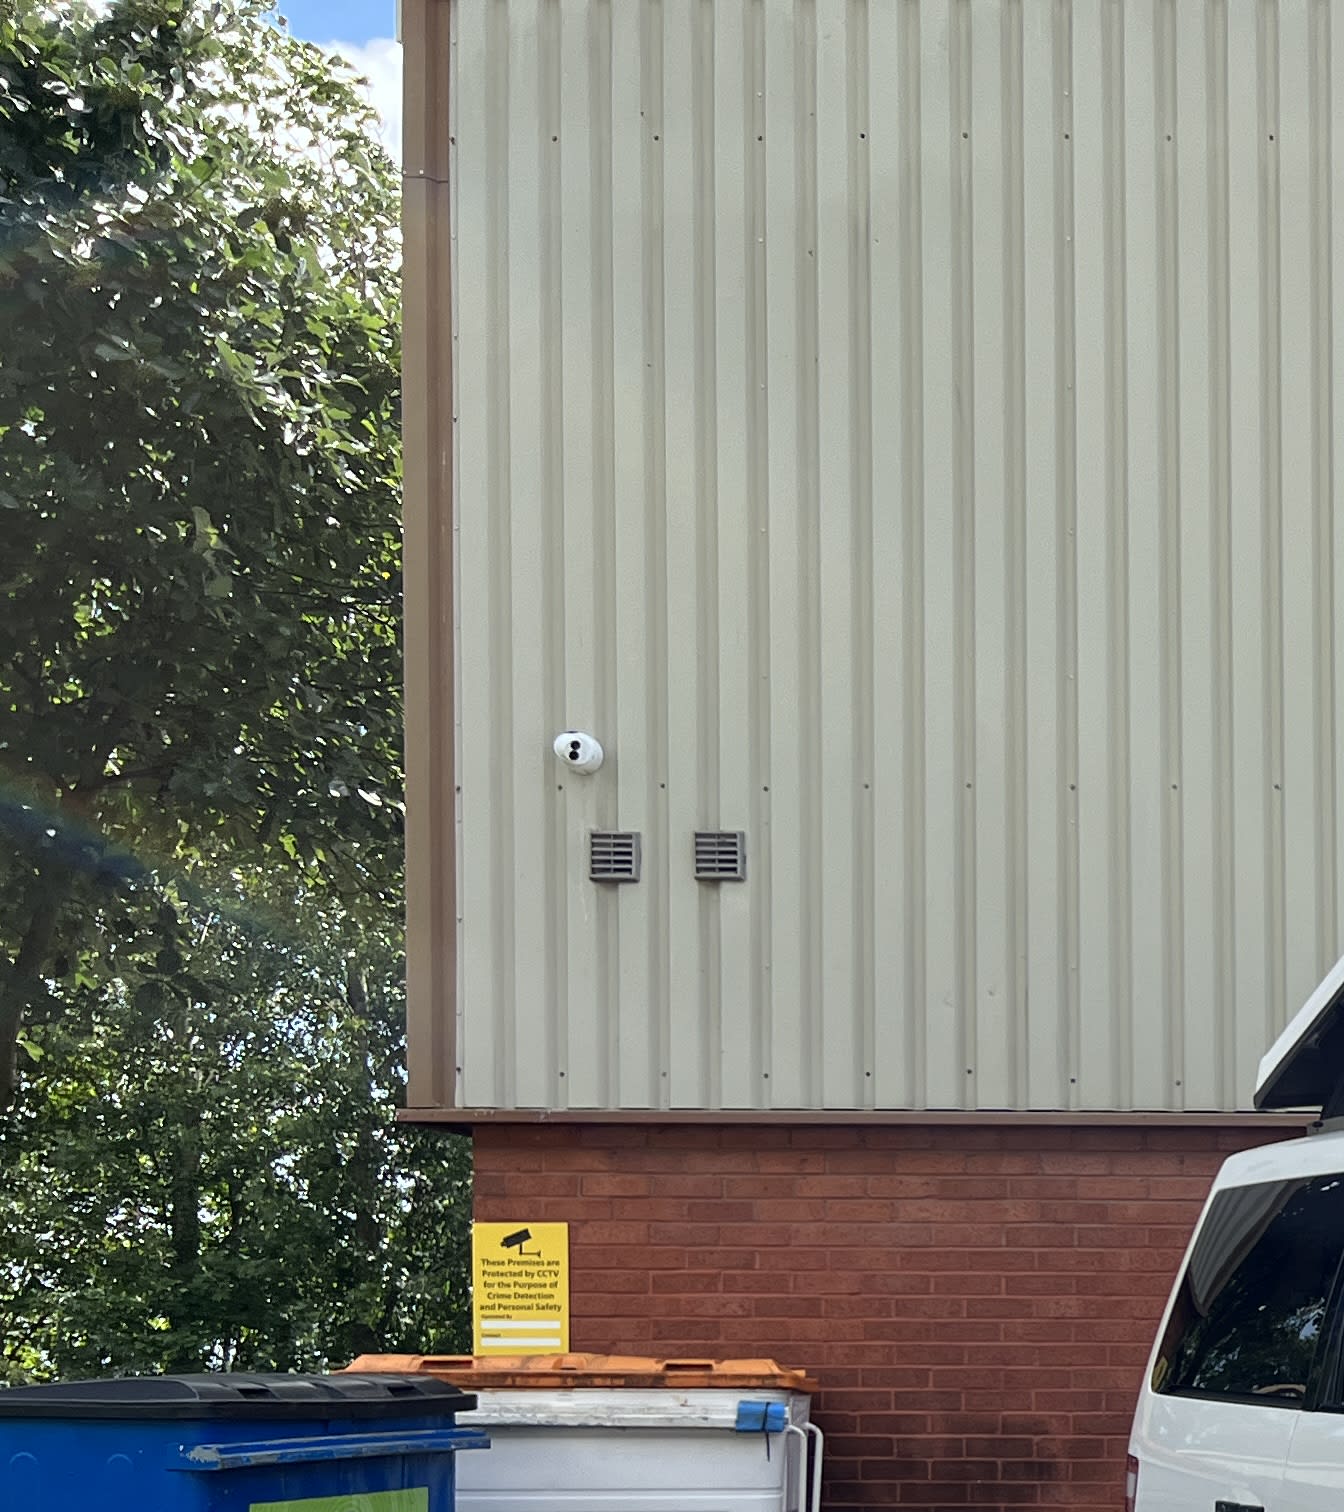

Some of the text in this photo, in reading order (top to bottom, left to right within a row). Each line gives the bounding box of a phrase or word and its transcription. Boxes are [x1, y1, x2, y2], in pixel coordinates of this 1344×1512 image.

[481, 1258, 506, 1267] These
[508, 1258, 545, 1267] Premises
[482, 1269, 560, 1279] Protected by CCTV
[484, 1280, 559, 1290] for the Purpose of
[487, 1292, 555, 1300] Crime Detection
[480, 1303, 562, 1313] and Personal Safety
